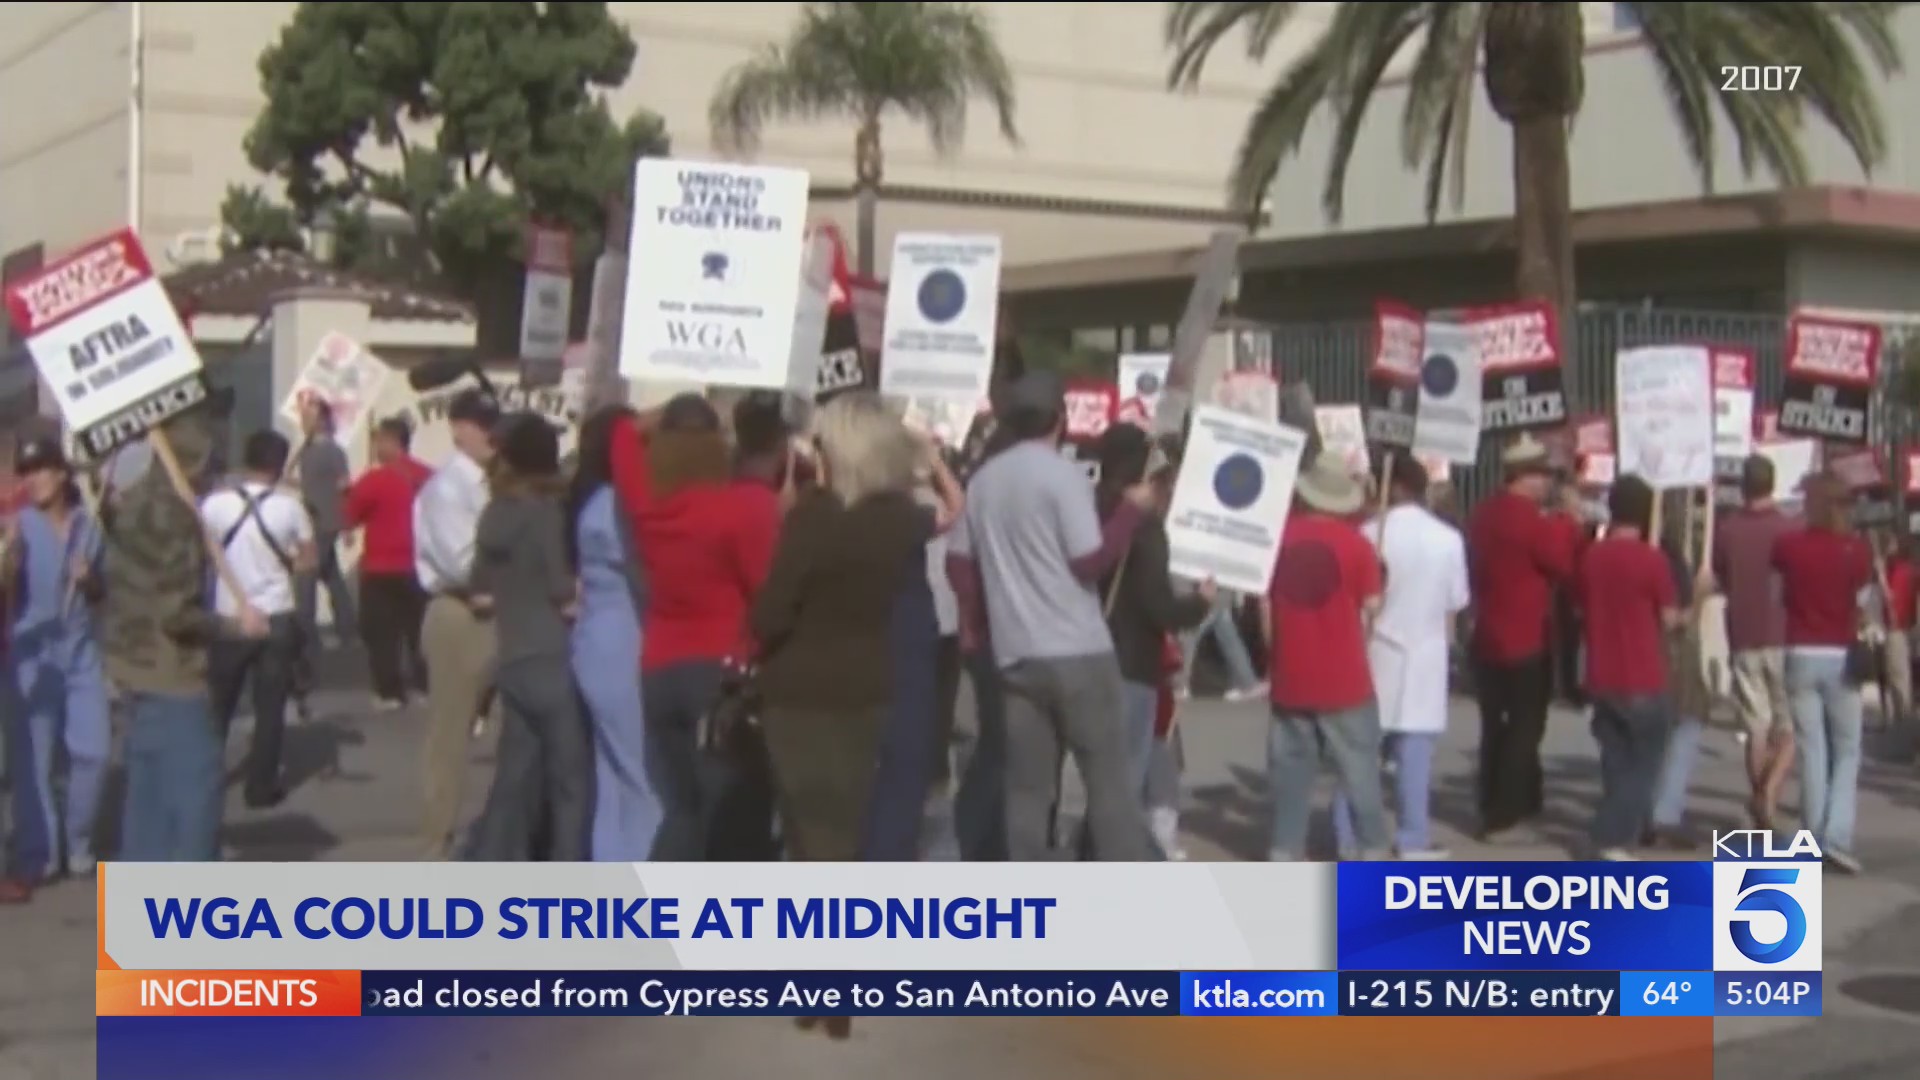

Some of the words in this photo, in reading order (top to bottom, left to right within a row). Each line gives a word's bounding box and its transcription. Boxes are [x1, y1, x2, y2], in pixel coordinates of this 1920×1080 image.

[677, 170, 765, 193] UNIONS
[682, 190, 758, 210] STAND
[656, 205, 783, 232] TOGETHER
[69, 313, 150, 372] AFTRA
[667, 319, 748, 358] WGA
[89, 377, 206, 456] STRIKE
[1780, 399, 1865, 438] STRIKE
